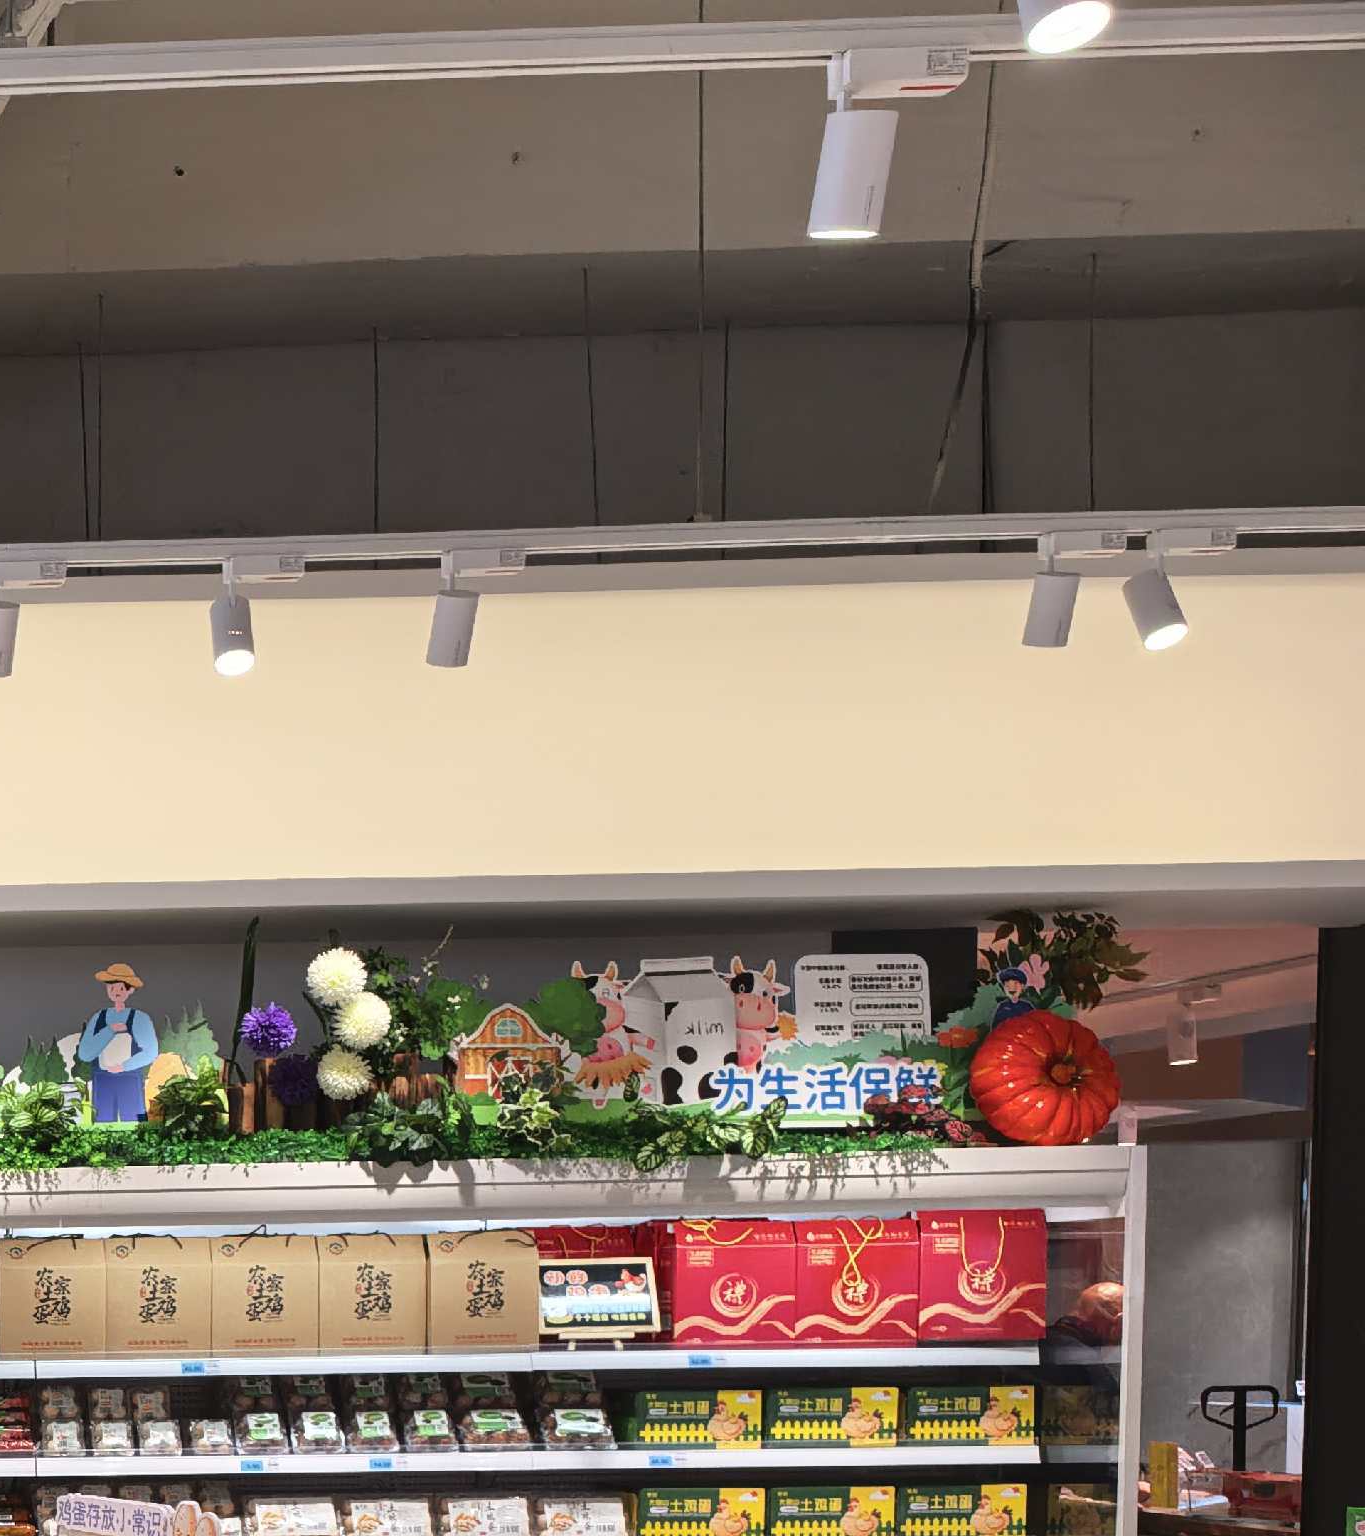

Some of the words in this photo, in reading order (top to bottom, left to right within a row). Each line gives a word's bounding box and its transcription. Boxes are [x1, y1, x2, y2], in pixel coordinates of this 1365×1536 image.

[715, 1065, 940, 1113] 为生活保鲜
